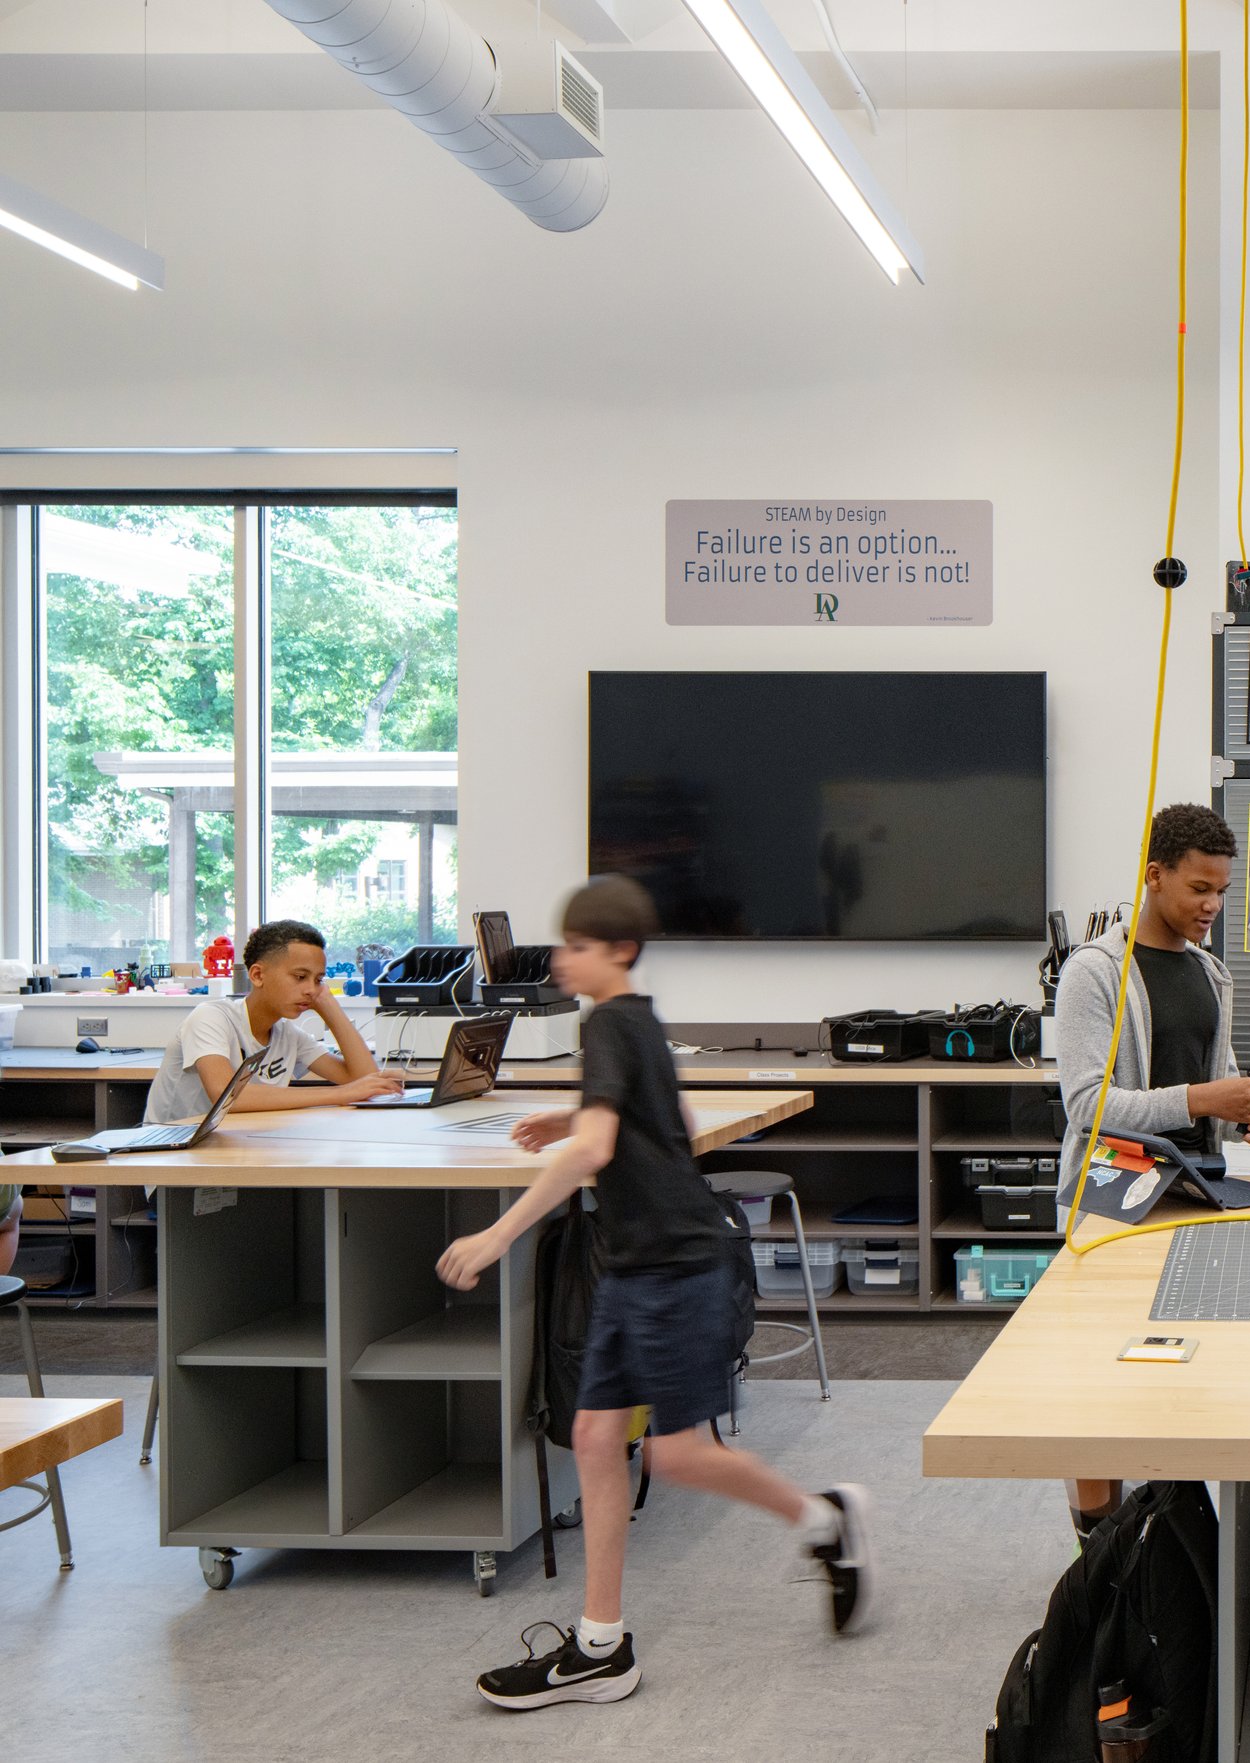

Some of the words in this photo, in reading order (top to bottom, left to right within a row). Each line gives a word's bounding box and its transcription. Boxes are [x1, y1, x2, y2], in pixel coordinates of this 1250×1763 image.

[766, 507, 812, 522] STEAM
[816, 506, 832, 525] by
[837, 506, 887, 526] Design
[697, 529, 782, 554] Failure
[792, 530, 811, 554] is
[819, 535, 849, 554] an
[858, 530, 957, 560] option...
[684, 560, 767, 583] Failure
[774, 563, 798, 583] to
[806, 559, 889, 583] deliver
[898, 560, 916, 583] is
[925, 562, 970, 583] not!
